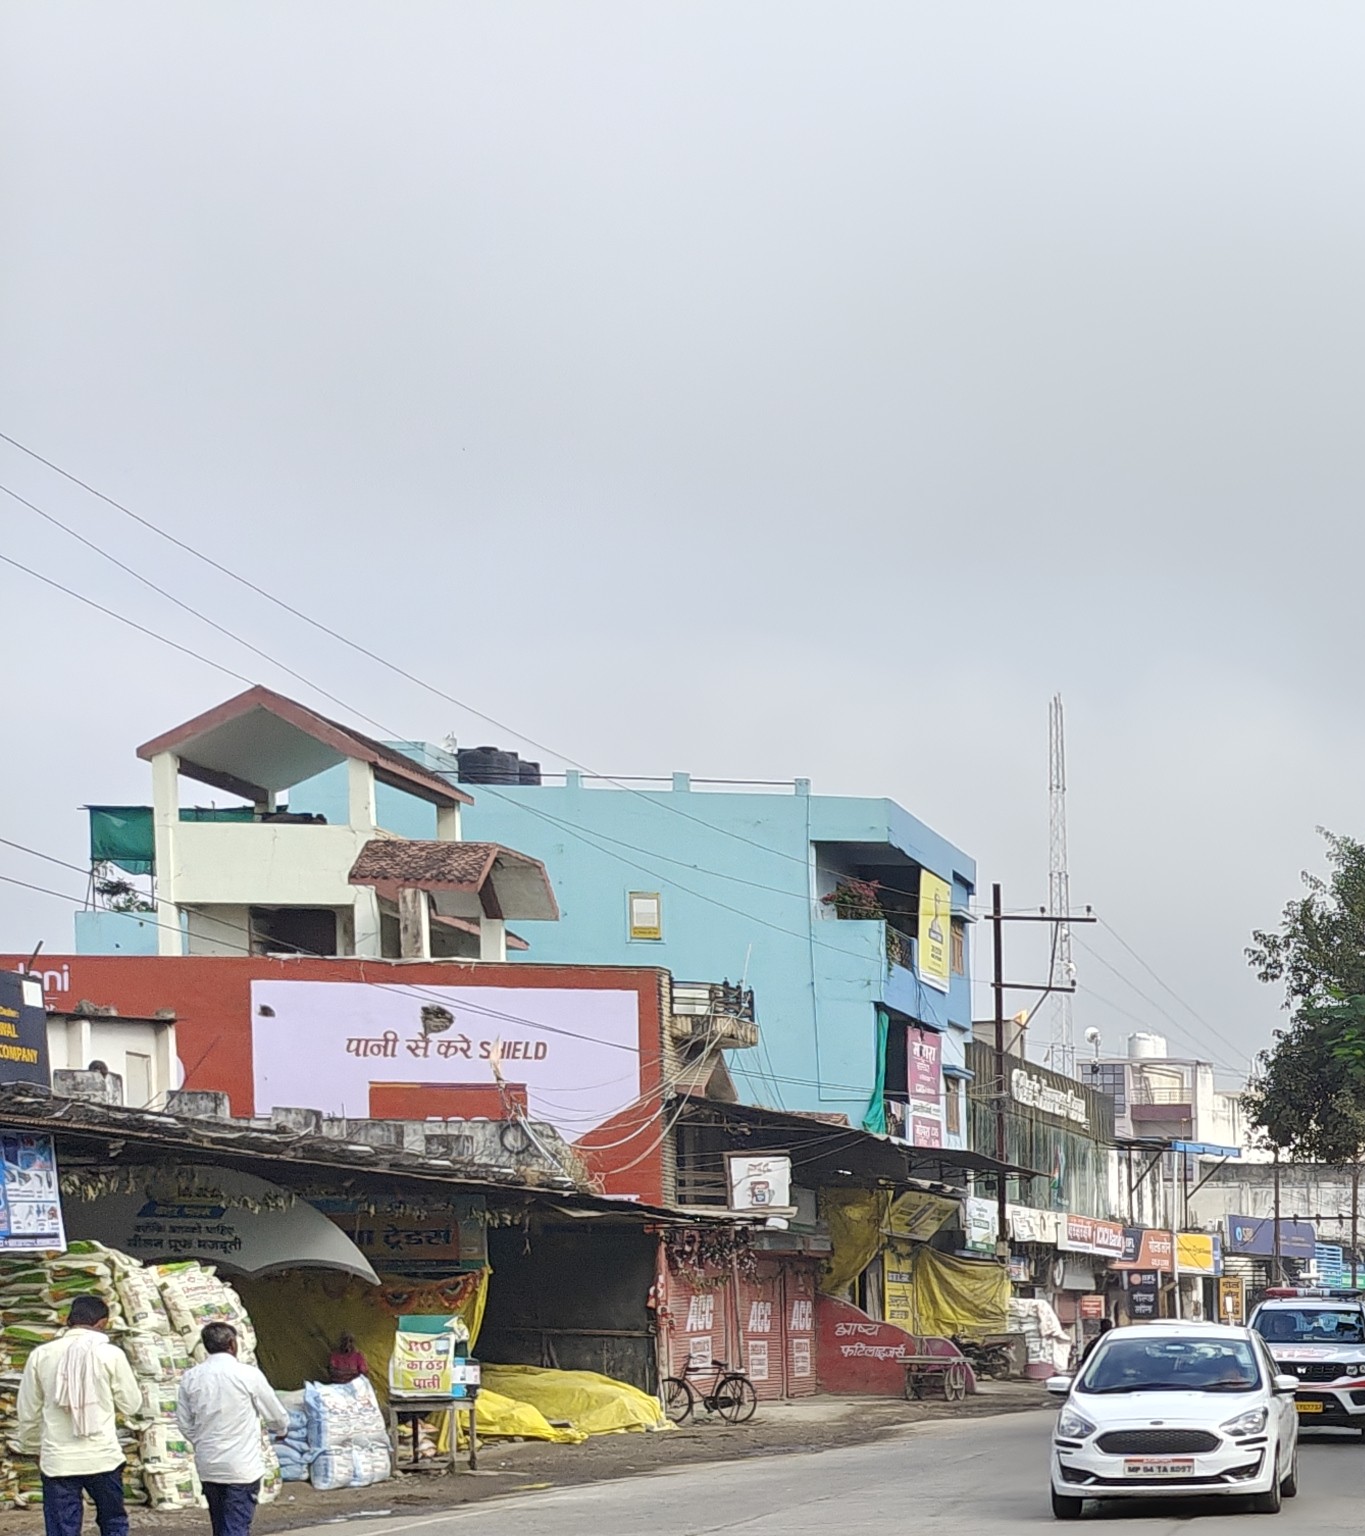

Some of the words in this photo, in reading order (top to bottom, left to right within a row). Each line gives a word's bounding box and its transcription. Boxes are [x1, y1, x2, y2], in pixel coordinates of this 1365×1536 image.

[346, 1030, 399, 1058] पानी
[437, 1033, 472, 1059] करे
[686, 1294, 714, 1332] ACC
[748, 1301, 772, 1332] ACC
[791, 1300, 813, 1331] ACC
